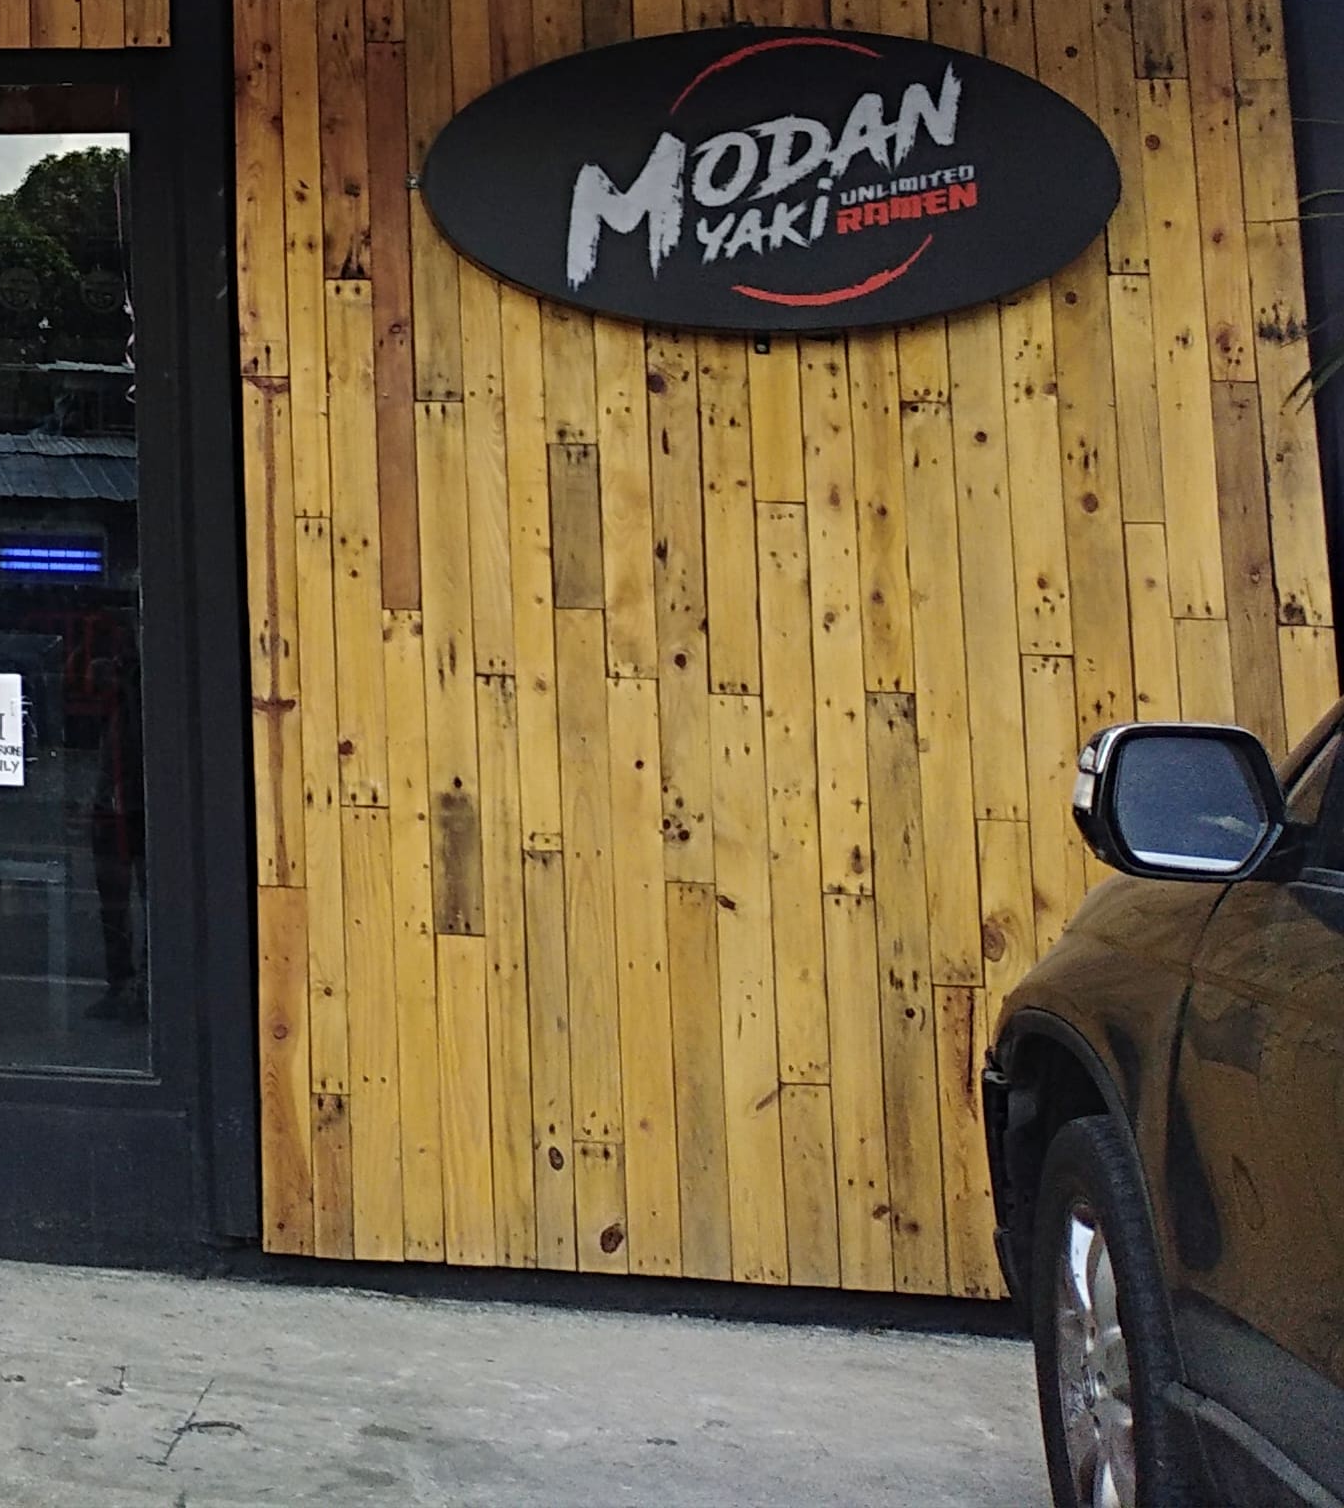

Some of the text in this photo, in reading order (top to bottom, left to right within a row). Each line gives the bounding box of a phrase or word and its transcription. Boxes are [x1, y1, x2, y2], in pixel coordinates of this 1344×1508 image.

[565, 60, 963, 291] MODAN
[839, 164, 976, 206] UNLIMITED
[835, 182, 979, 235] RAMEN
